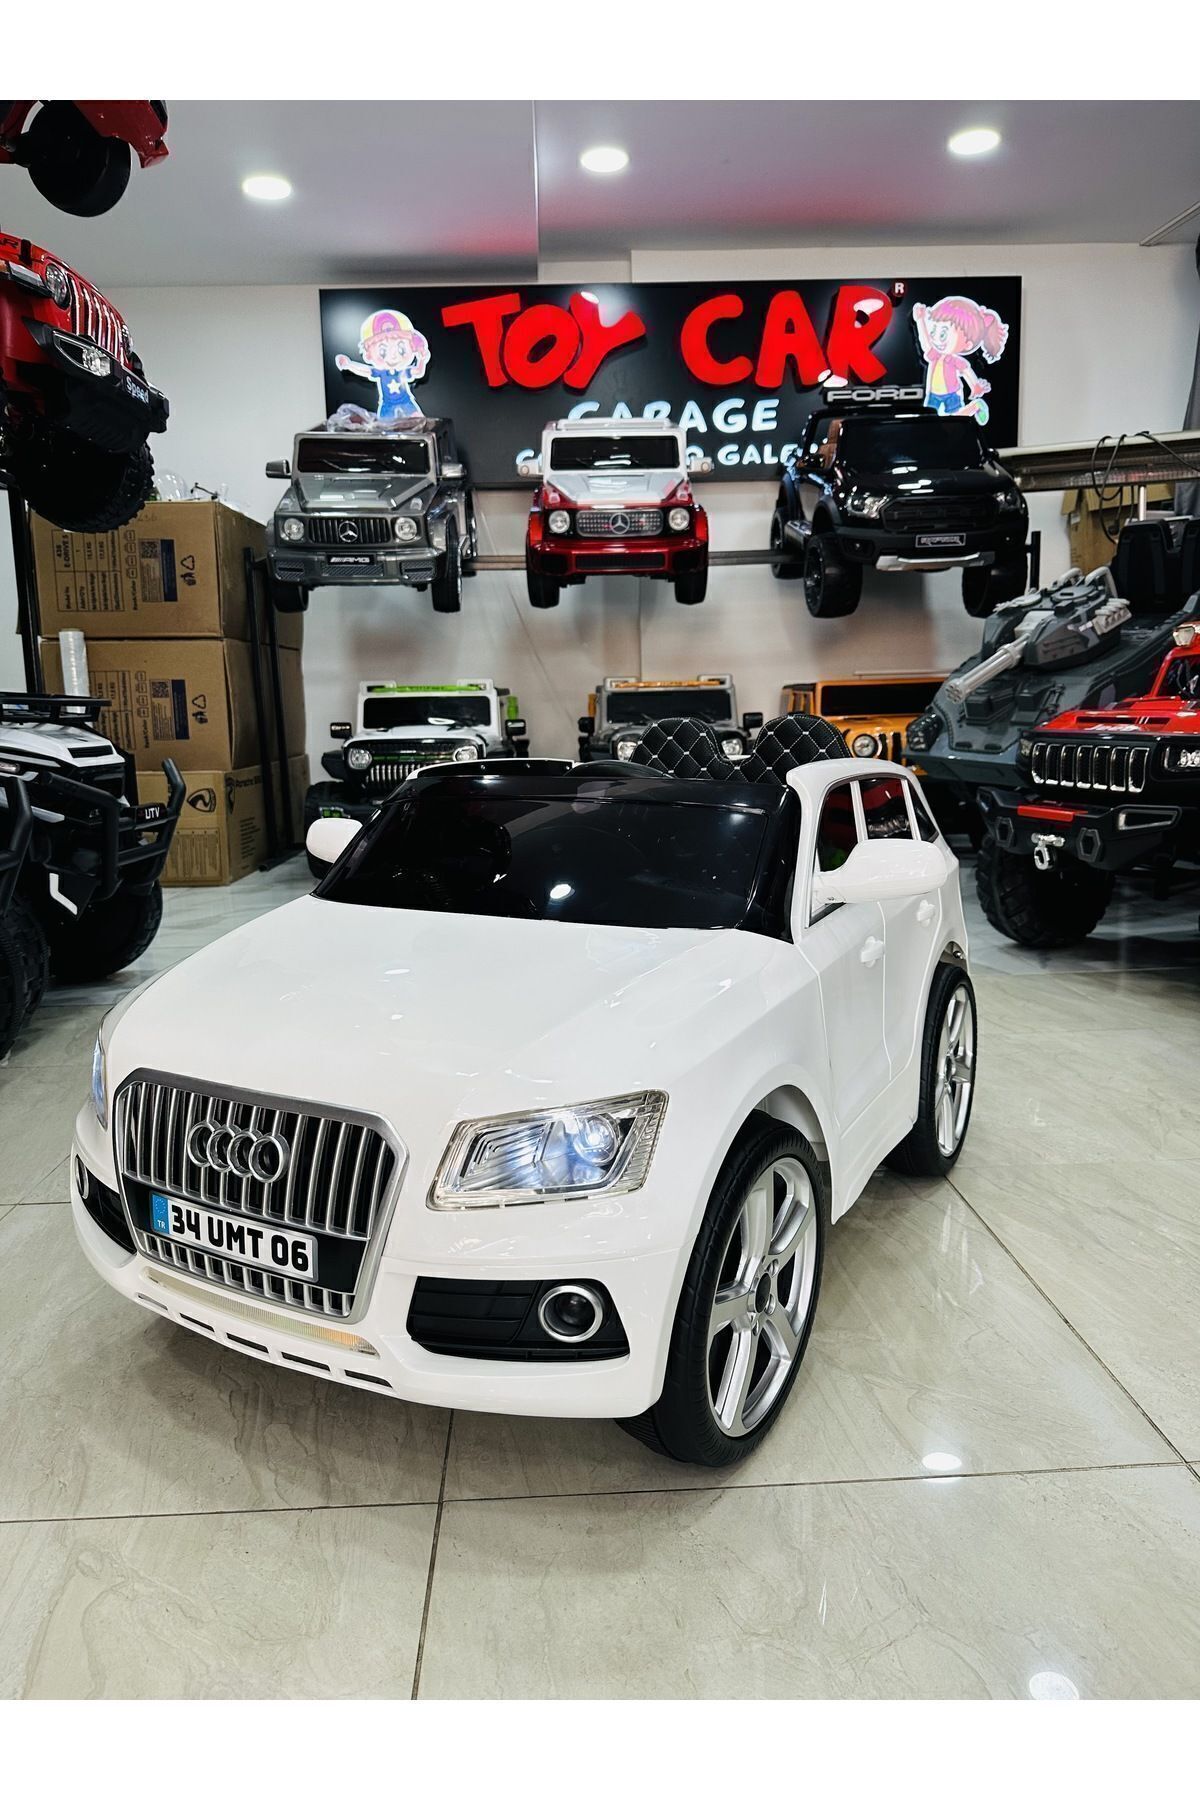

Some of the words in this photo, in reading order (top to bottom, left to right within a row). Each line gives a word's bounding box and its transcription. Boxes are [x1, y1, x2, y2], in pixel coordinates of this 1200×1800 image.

[442, 290, 646, 389] TOY
[681, 285, 893, 388] CAR
[827, 387, 925, 403] FORD
[144, 806, 160, 820] UTV
[157, 1219, 166, 1230] TR
[172, 1205, 201, 1241] 34
[207, 1215, 264, 1260] UMT
[270, 1234, 309, 1273] 06
